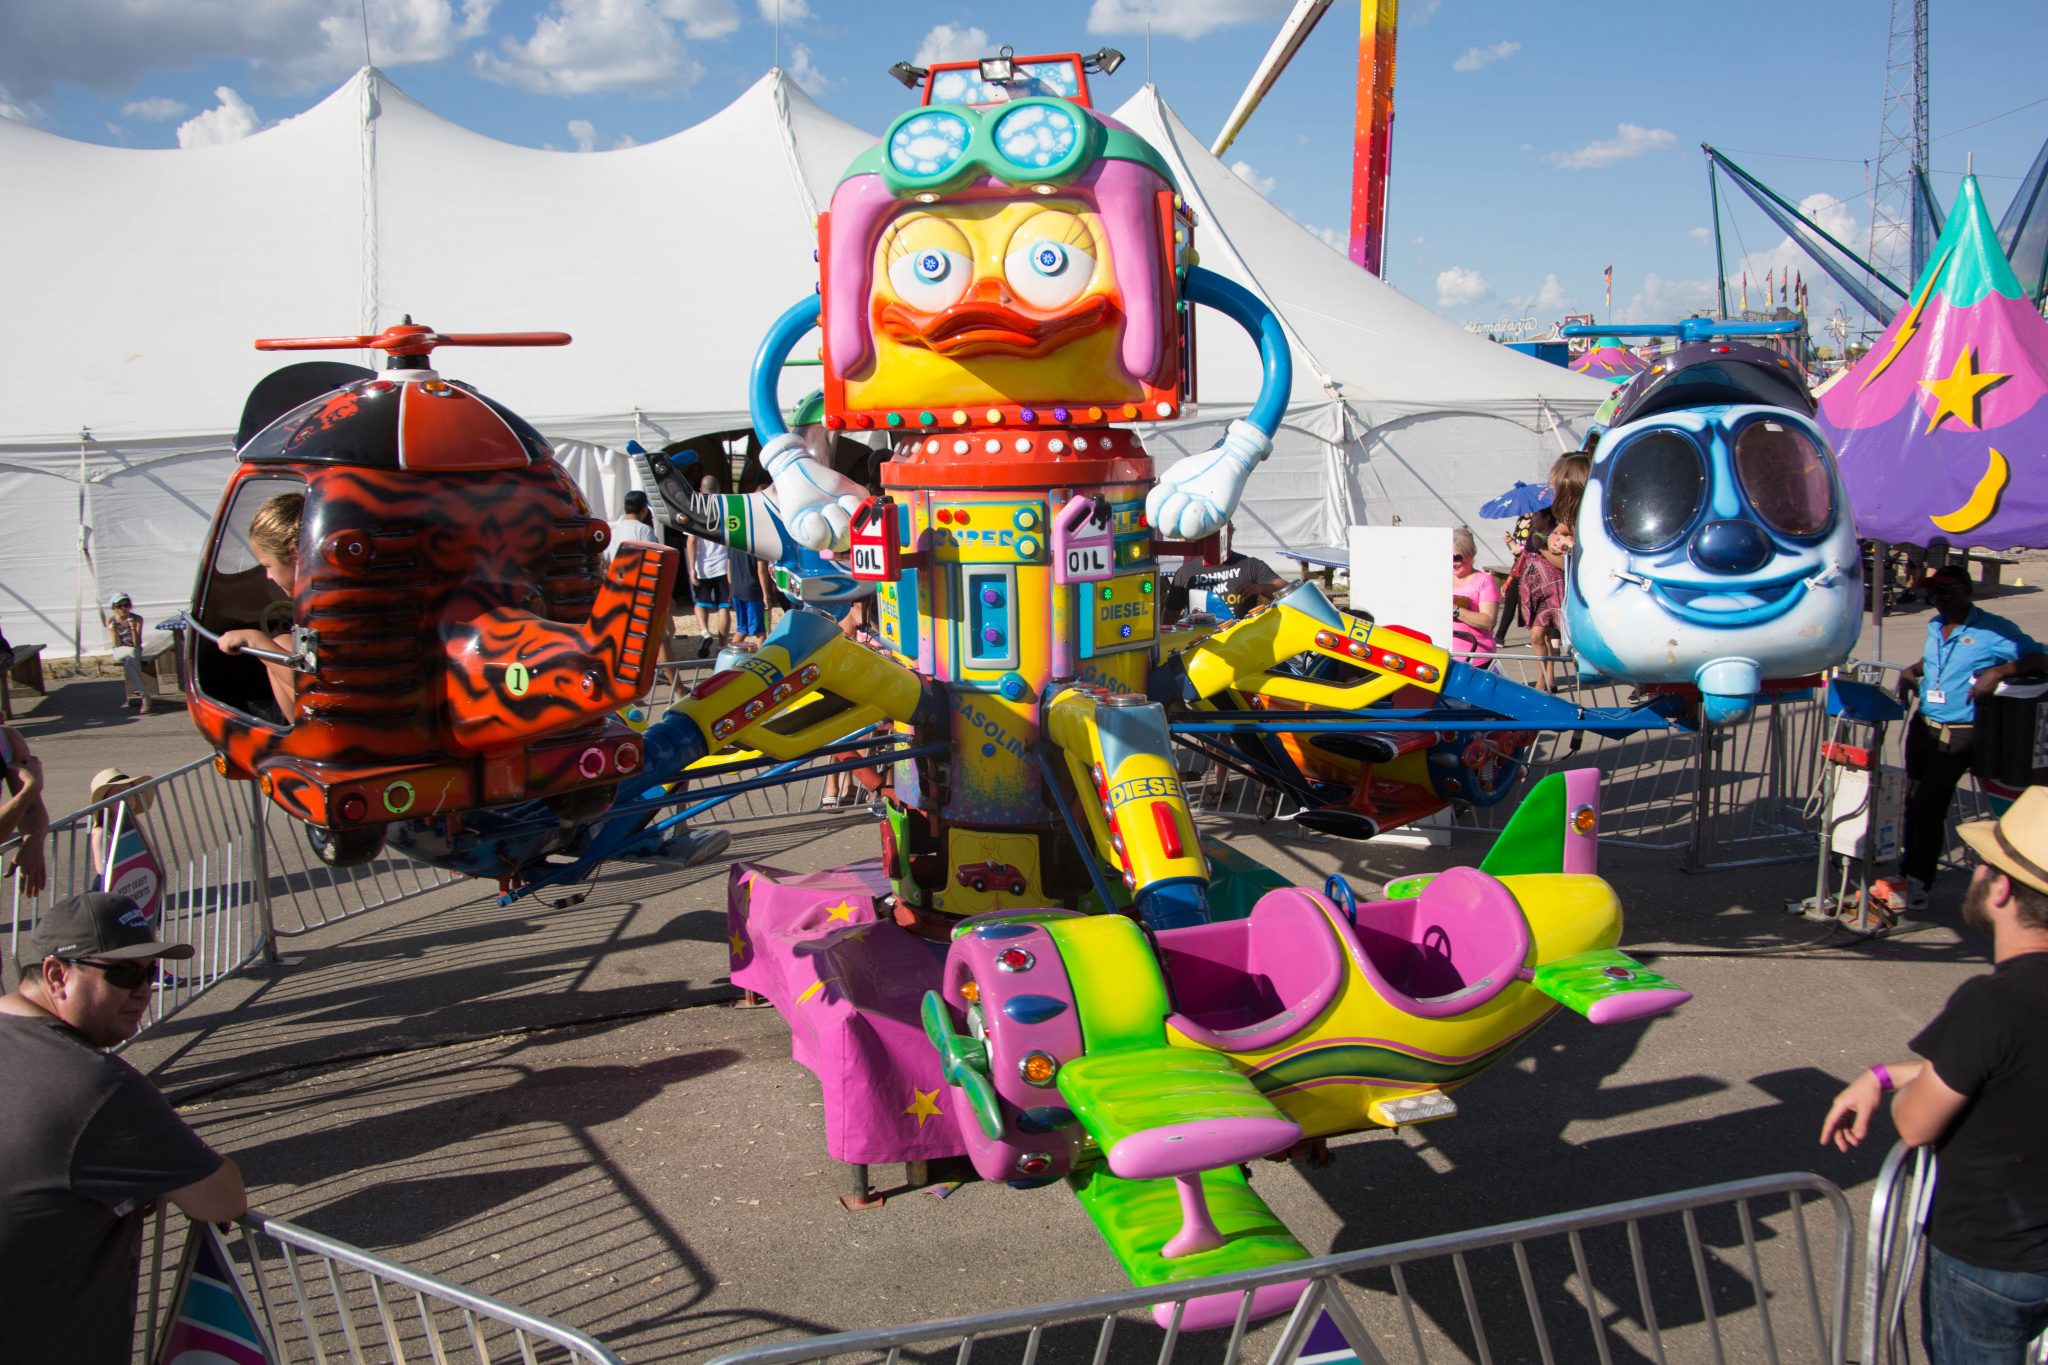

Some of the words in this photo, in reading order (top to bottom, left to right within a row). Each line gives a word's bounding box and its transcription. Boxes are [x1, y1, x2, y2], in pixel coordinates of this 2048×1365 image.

[1464, 317, 1537, 336] Himalaya
[728, 518, 738, 530] 5
[933, 529, 1016, 547] SUPER
[855, 548, 881, 571] OIL
[1069, 550, 1105, 572] OIL
[1195, 568, 1240, 584] JOHNNY
[1101, 602, 1148, 621] DIESEL
[513, 668, 523, 691] 1
[951, 695, 1029, 762] GASOLIN
